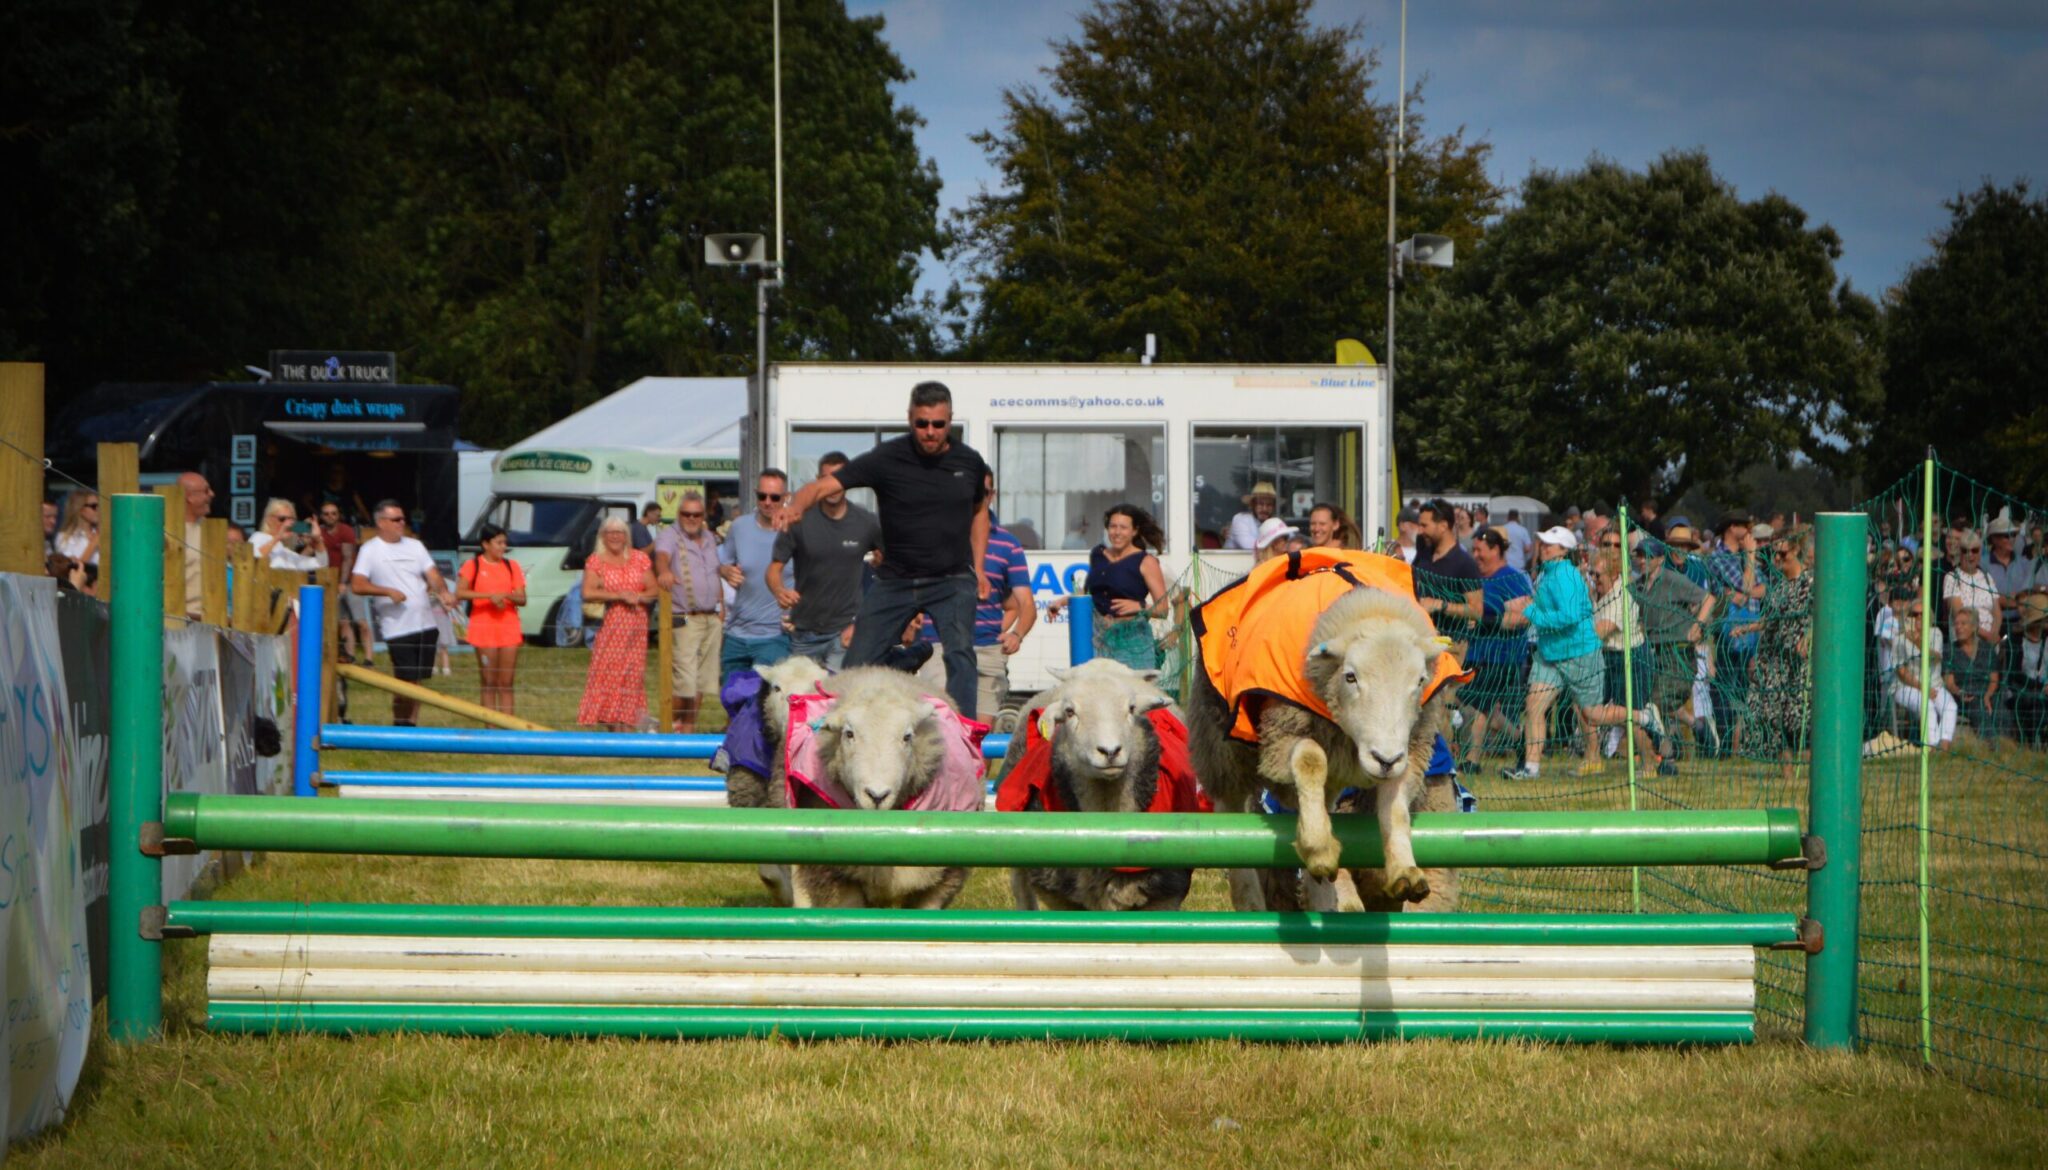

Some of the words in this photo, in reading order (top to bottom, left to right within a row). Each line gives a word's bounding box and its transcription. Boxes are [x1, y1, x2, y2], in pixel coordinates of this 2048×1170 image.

[280, 364, 306, 380] THE
[310, 364, 345, 380] DUCK
[347, 365, 389, 380] TRUCK
[1320, 377, 1346, 388] Blue
[1349, 377, 1376, 388] Line
[285, 398, 327, 418] Crispy
[331, 398, 363, 416] duck
[366, 402, 405, 419] wraps
[989, 396, 1165, 409] acecomms@yahoo.co.uk
[554, 459, 590, 472] CREAM
